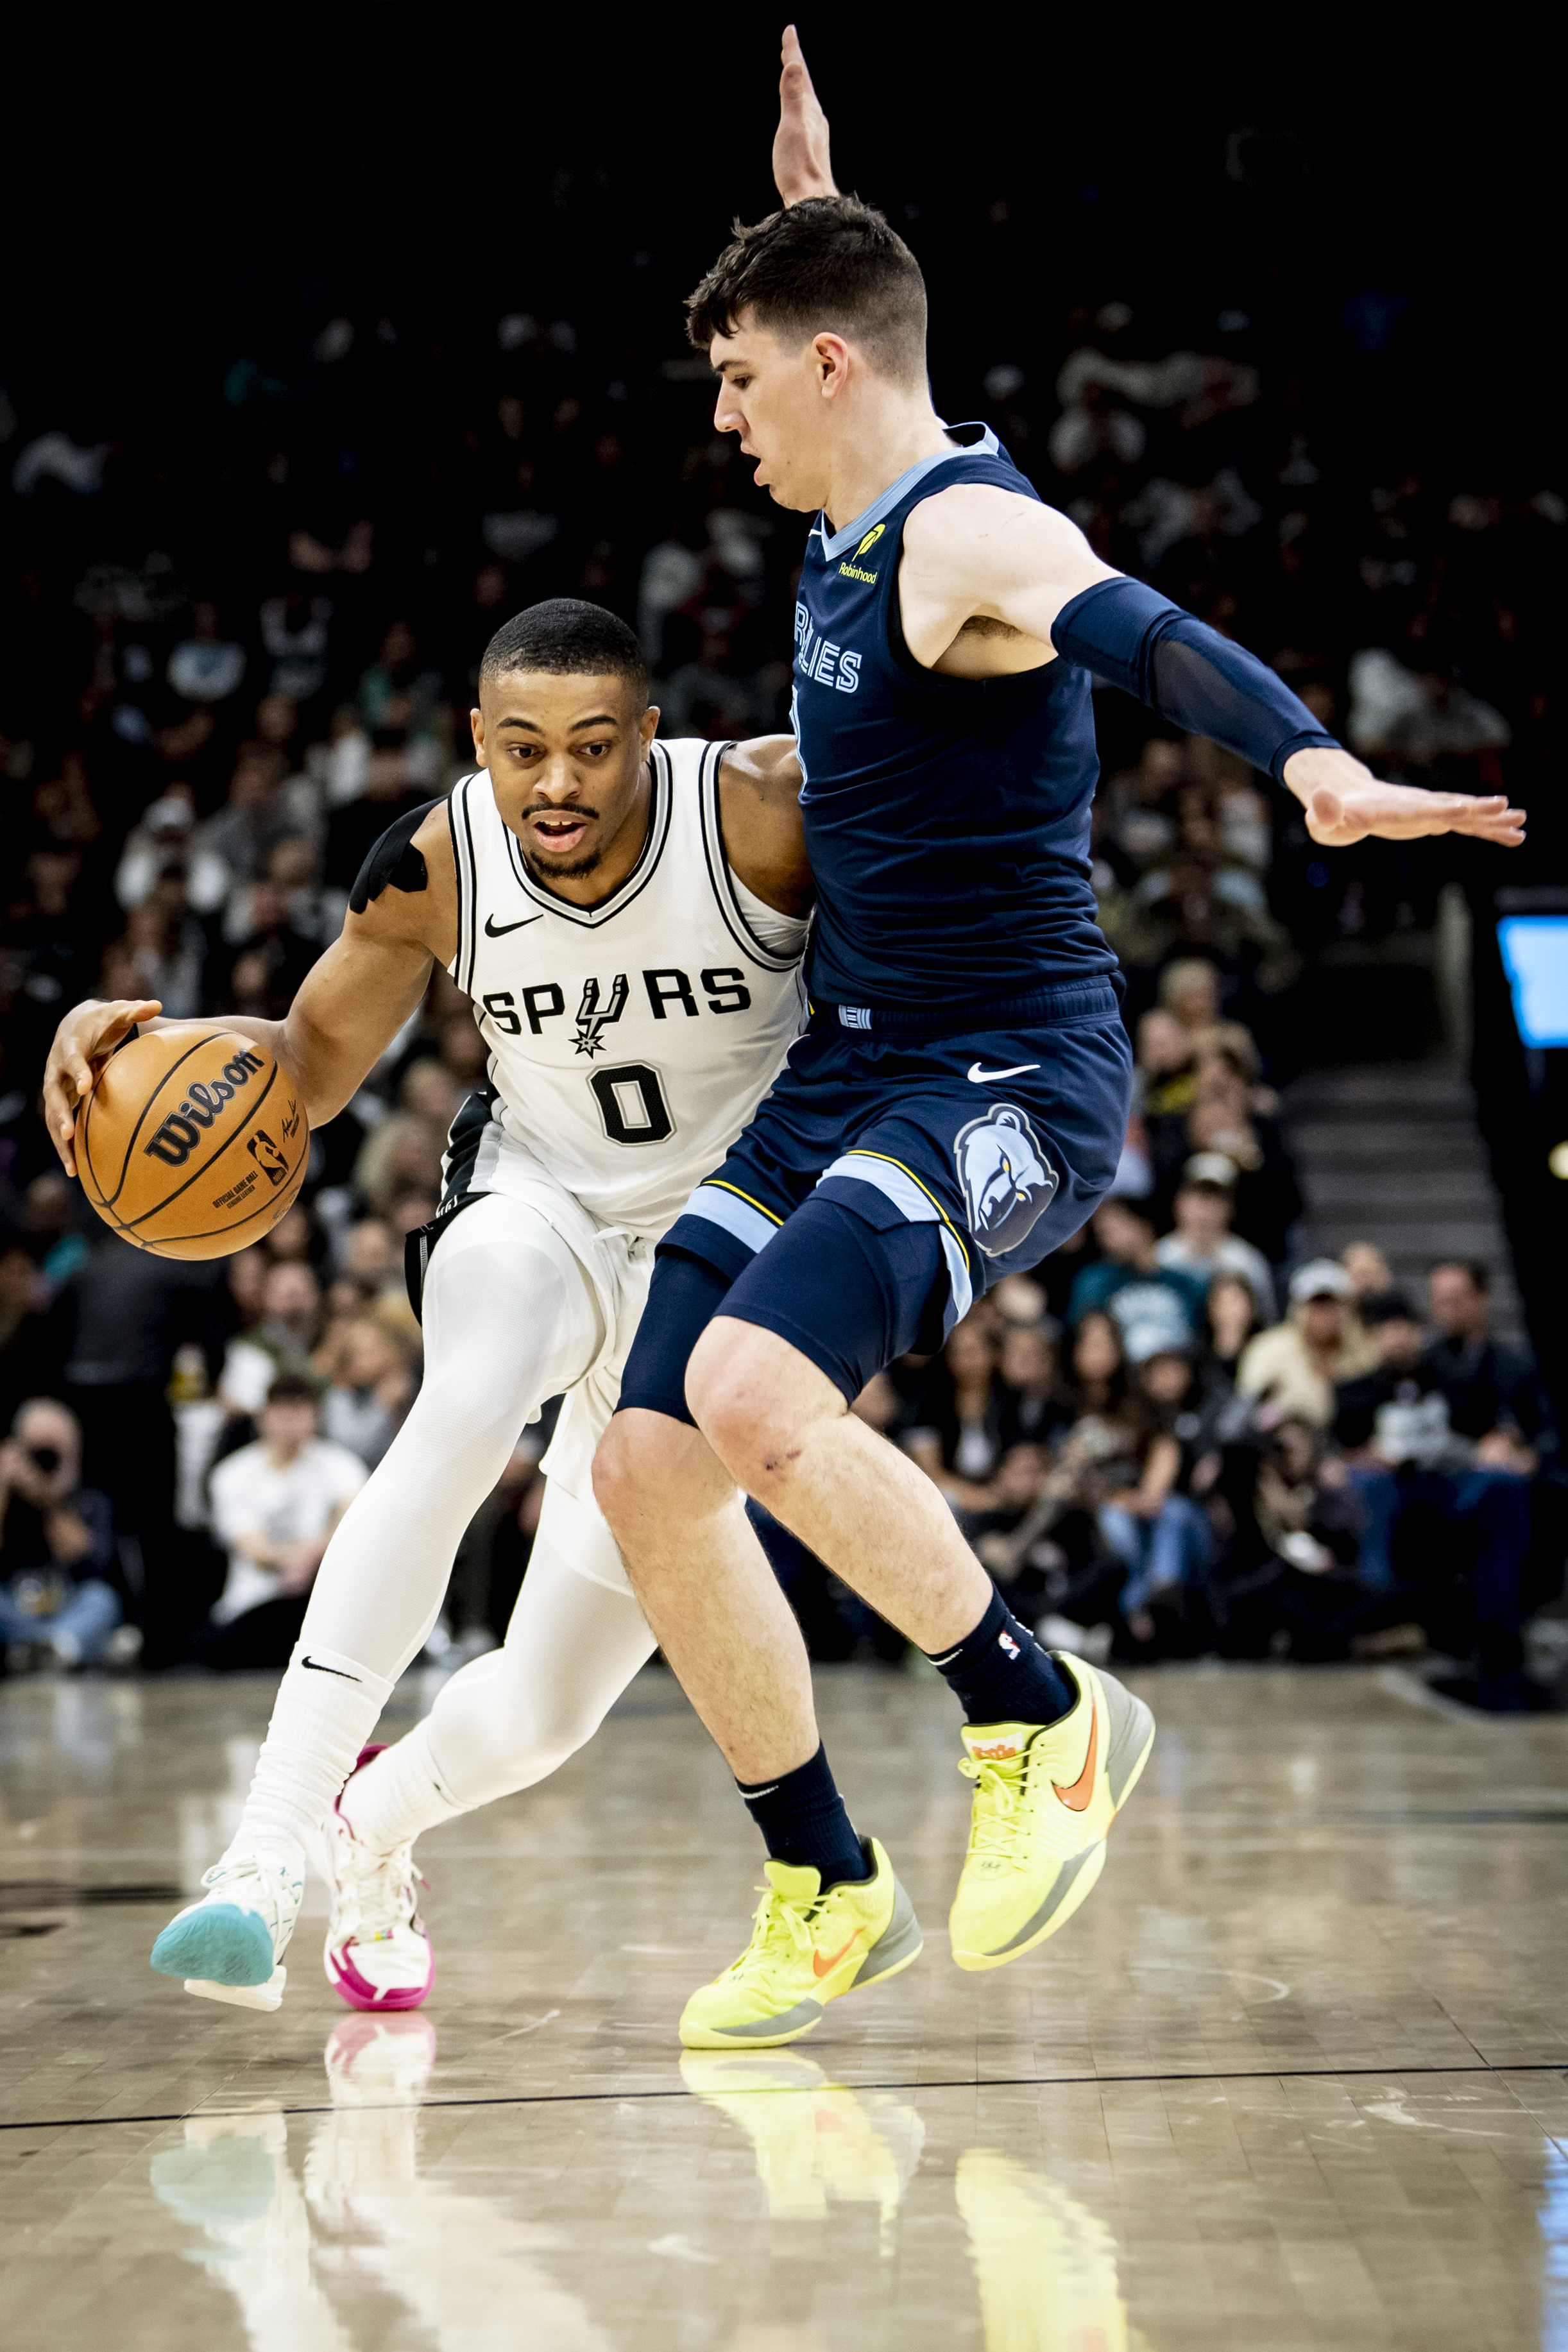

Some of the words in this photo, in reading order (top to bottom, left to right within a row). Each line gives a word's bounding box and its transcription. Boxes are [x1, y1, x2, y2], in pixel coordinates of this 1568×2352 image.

[839, 562, 878, 584] Robinhood
[482, 967, 751, 1059] SPURS
[144, 1049, 265, 1166] Wilson
[585, 1059, 677, 1148] 0
[212, 1189, 236, 1209] OFFICIAL
[233, 1179, 249, 1195] GAME
[245, 1170, 259, 1184] BALL
[240, 1184, 256, 1199] LEATHER
